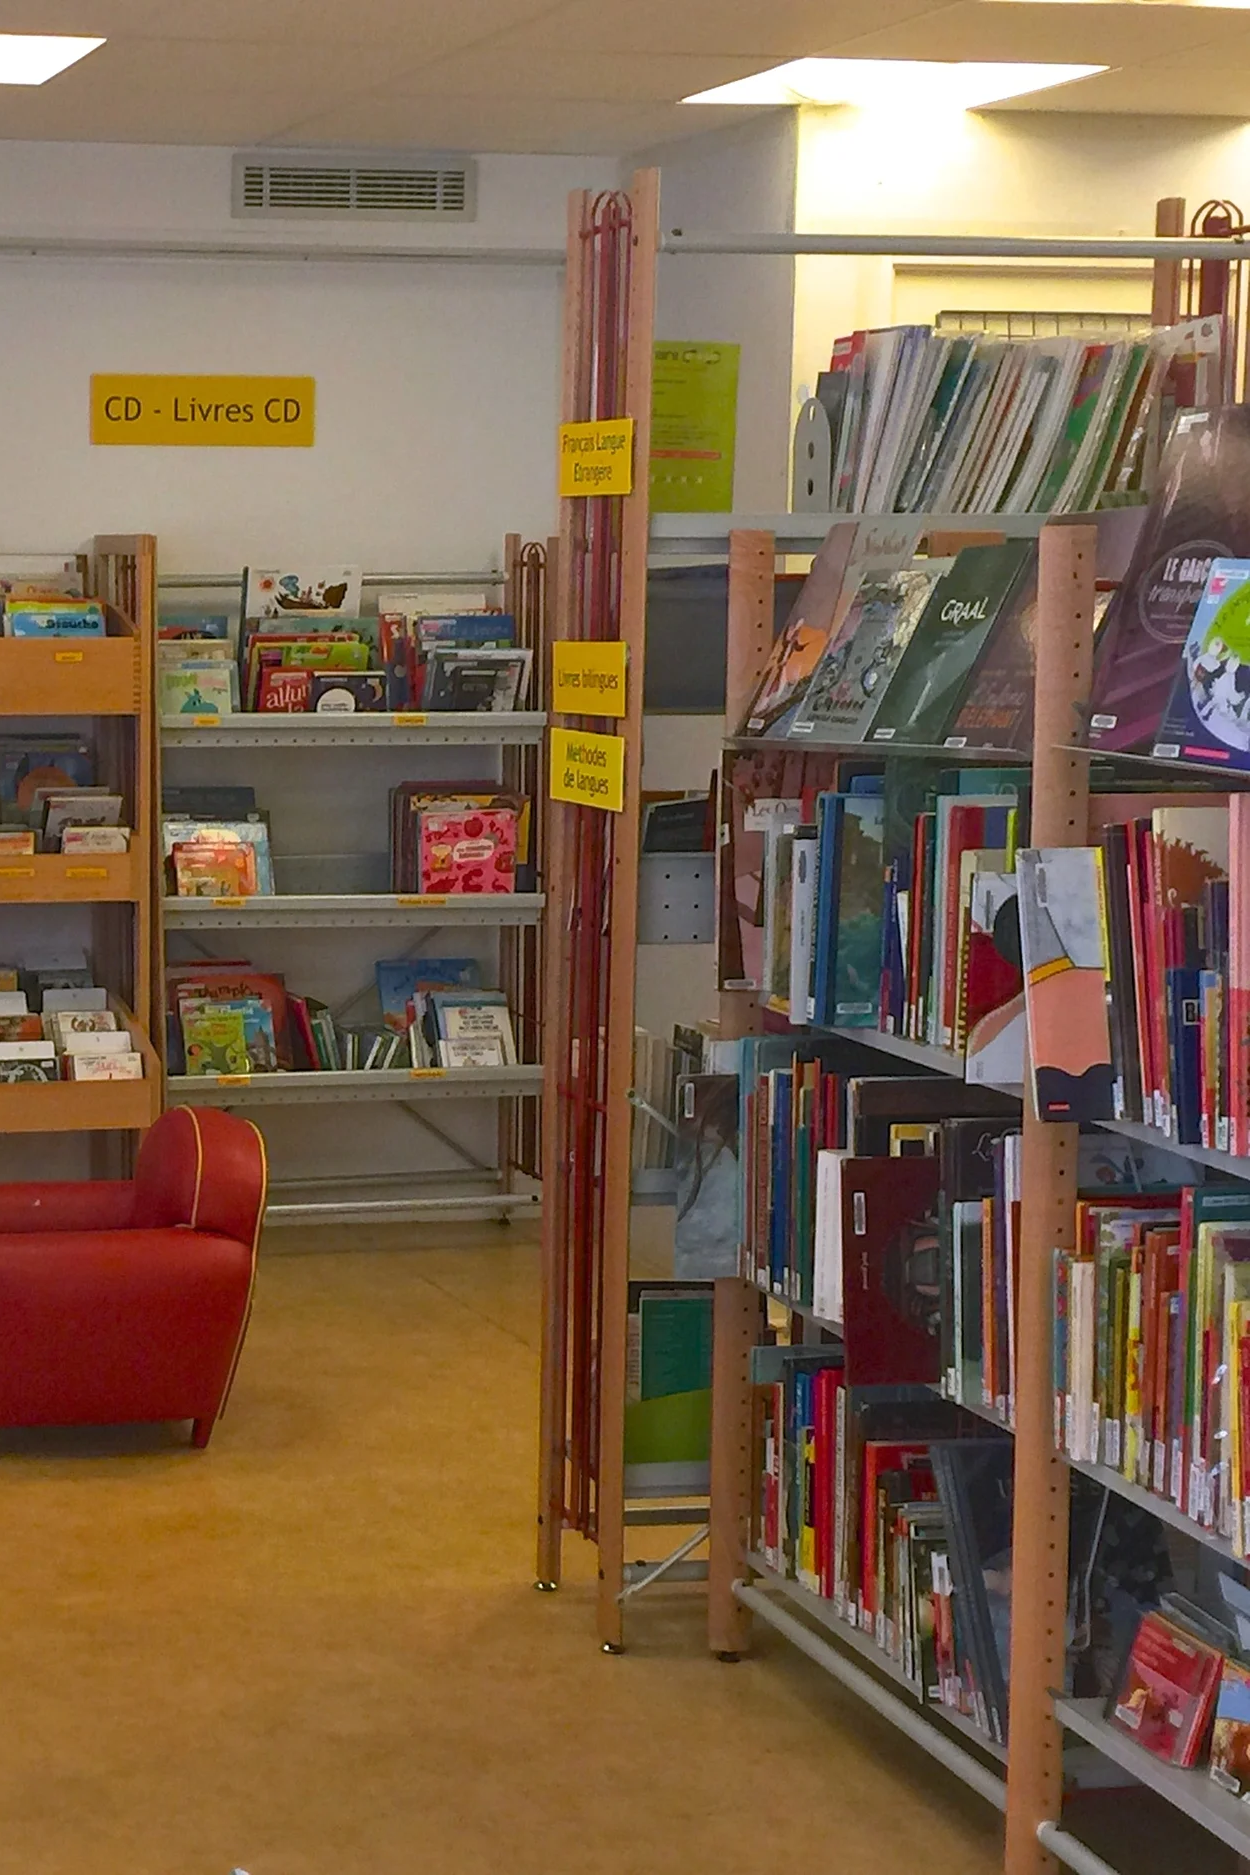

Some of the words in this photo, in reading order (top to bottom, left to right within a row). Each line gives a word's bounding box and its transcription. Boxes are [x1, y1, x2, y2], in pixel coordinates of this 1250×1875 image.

[105, 396, 142, 422] CD
[173, 397, 254, 423] Livres
[264, 398, 301, 423] CD
[940, 596, 989, 625] GRAAL
[557, 668, 581, 688] Livres
[582, 668, 619, 694] bilingues
[566, 740, 607, 768] Méthodes
[563, 767, 575, 789] de
[576, 768, 609, 797] langues
